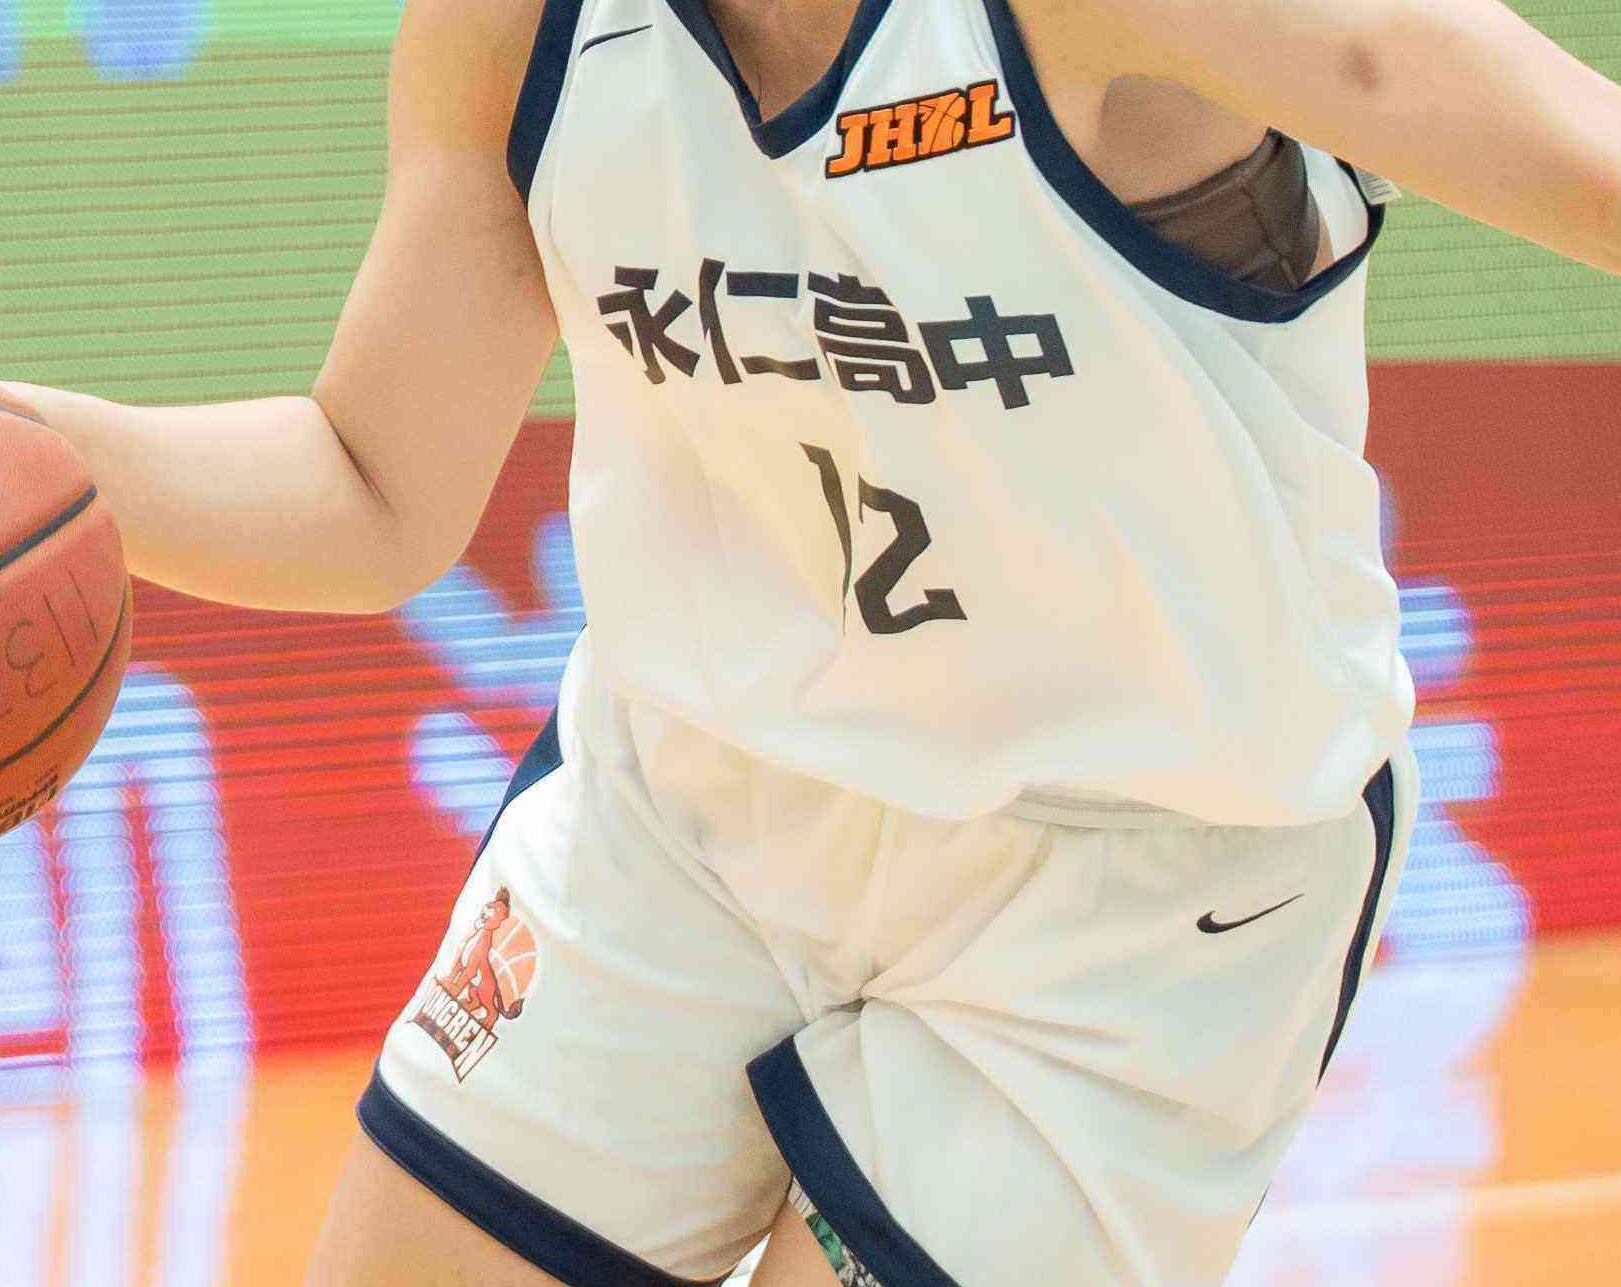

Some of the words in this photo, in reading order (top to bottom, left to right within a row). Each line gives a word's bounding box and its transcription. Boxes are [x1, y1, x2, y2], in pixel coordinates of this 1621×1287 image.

[825, 79, 1015, 179] JHBL
[596, 257, 1075, 410] 永仁高中
[798, 441, 967, 635] 12
